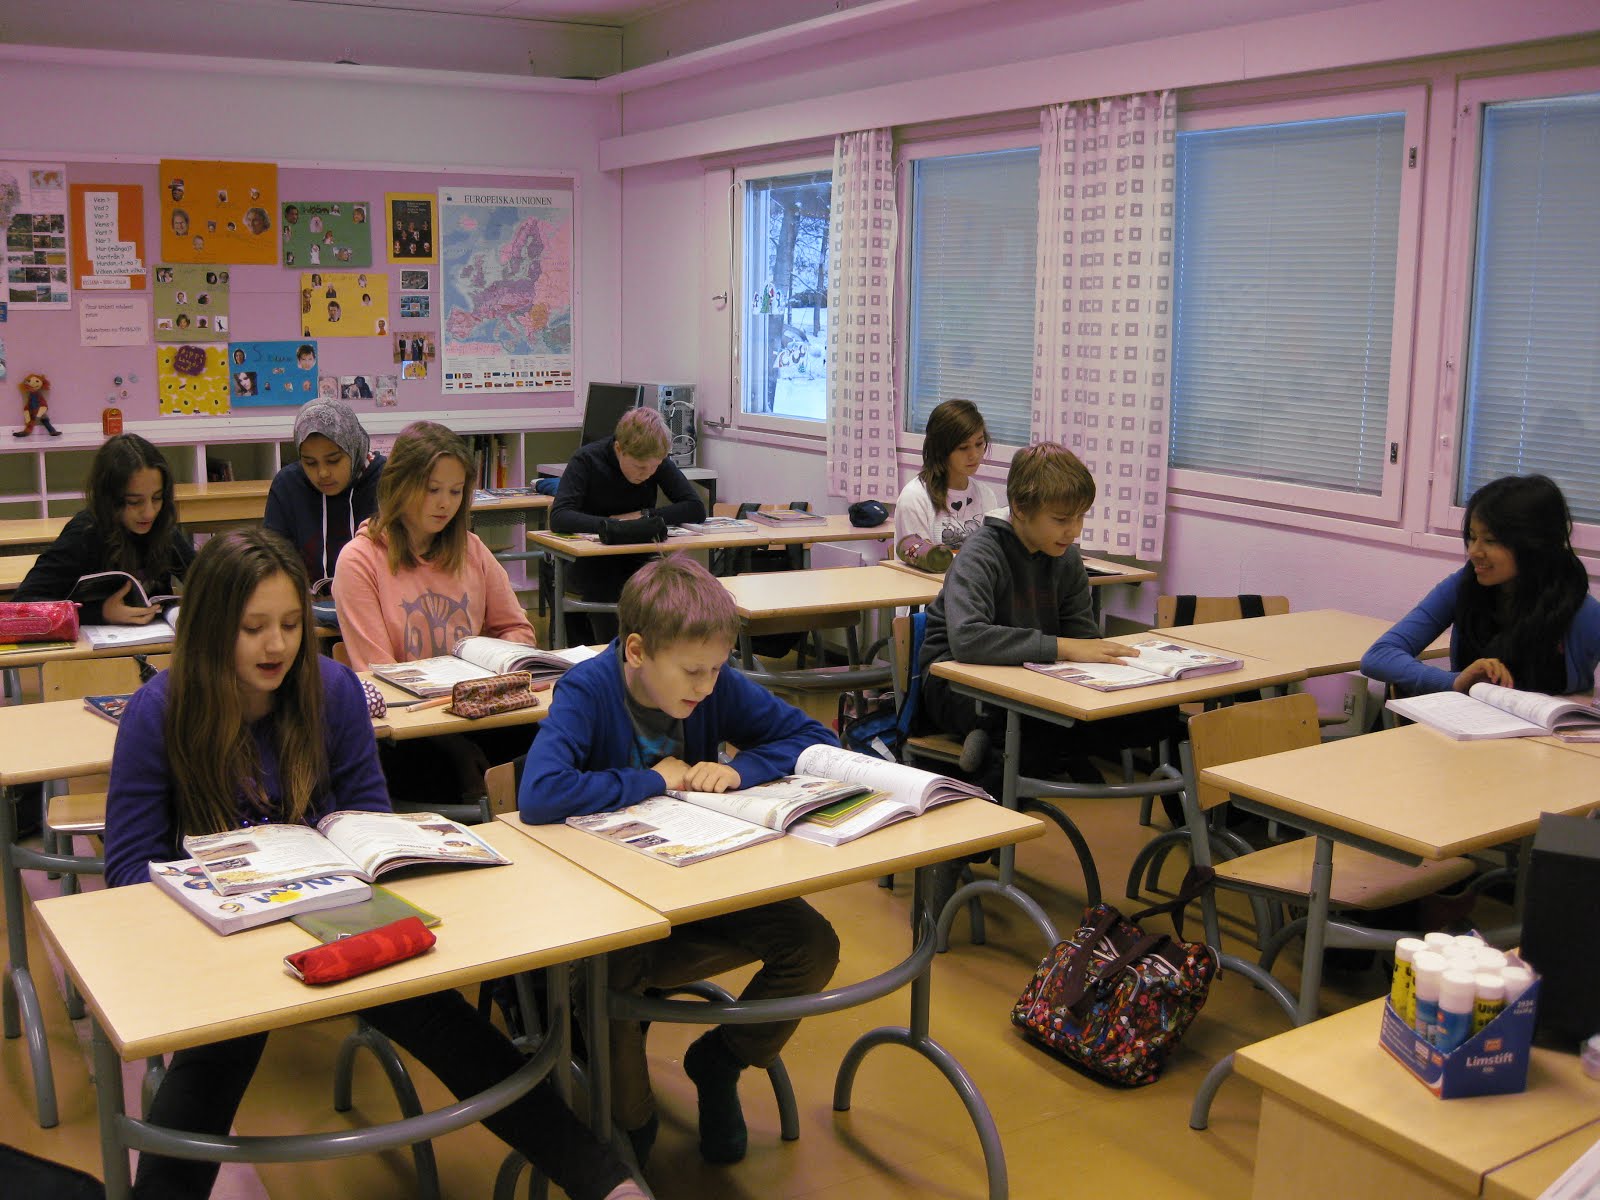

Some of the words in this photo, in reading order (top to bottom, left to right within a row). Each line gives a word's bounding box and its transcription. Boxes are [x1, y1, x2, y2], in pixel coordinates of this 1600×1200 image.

[464, 194, 514, 204] EUROPEISKA
[516, 196, 552, 205] UNIONEN
[1465, 1052, 1514, 1067] Limstift
